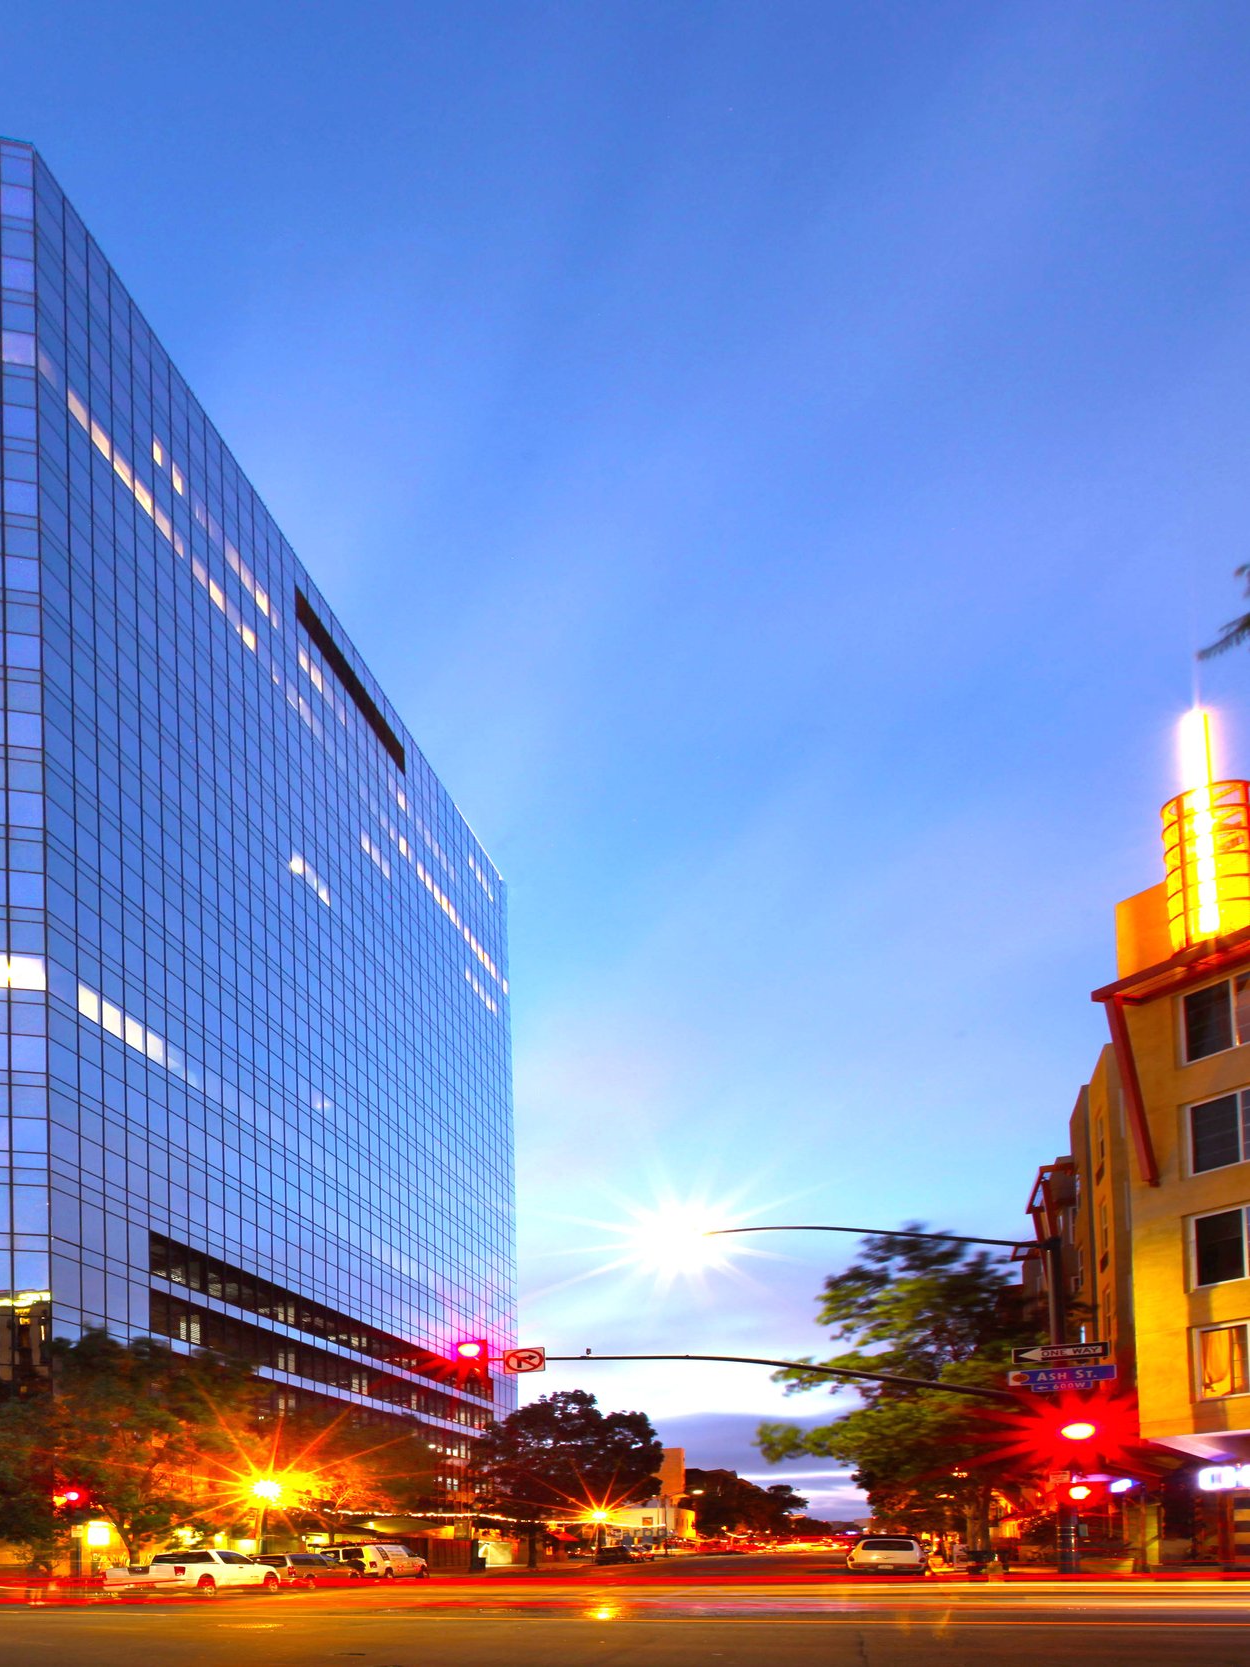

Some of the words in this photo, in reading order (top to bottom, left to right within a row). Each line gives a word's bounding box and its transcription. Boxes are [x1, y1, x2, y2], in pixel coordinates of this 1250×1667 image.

[1041, 1349, 1068, 1358] ONE
[1072, 1346, 1100, 1355] WAY
[1036, 1371, 1068, 1382] ASH
[1075, 1369, 1098, 1379] ST.
[1053, 1382, 1085, 1390] 600W
